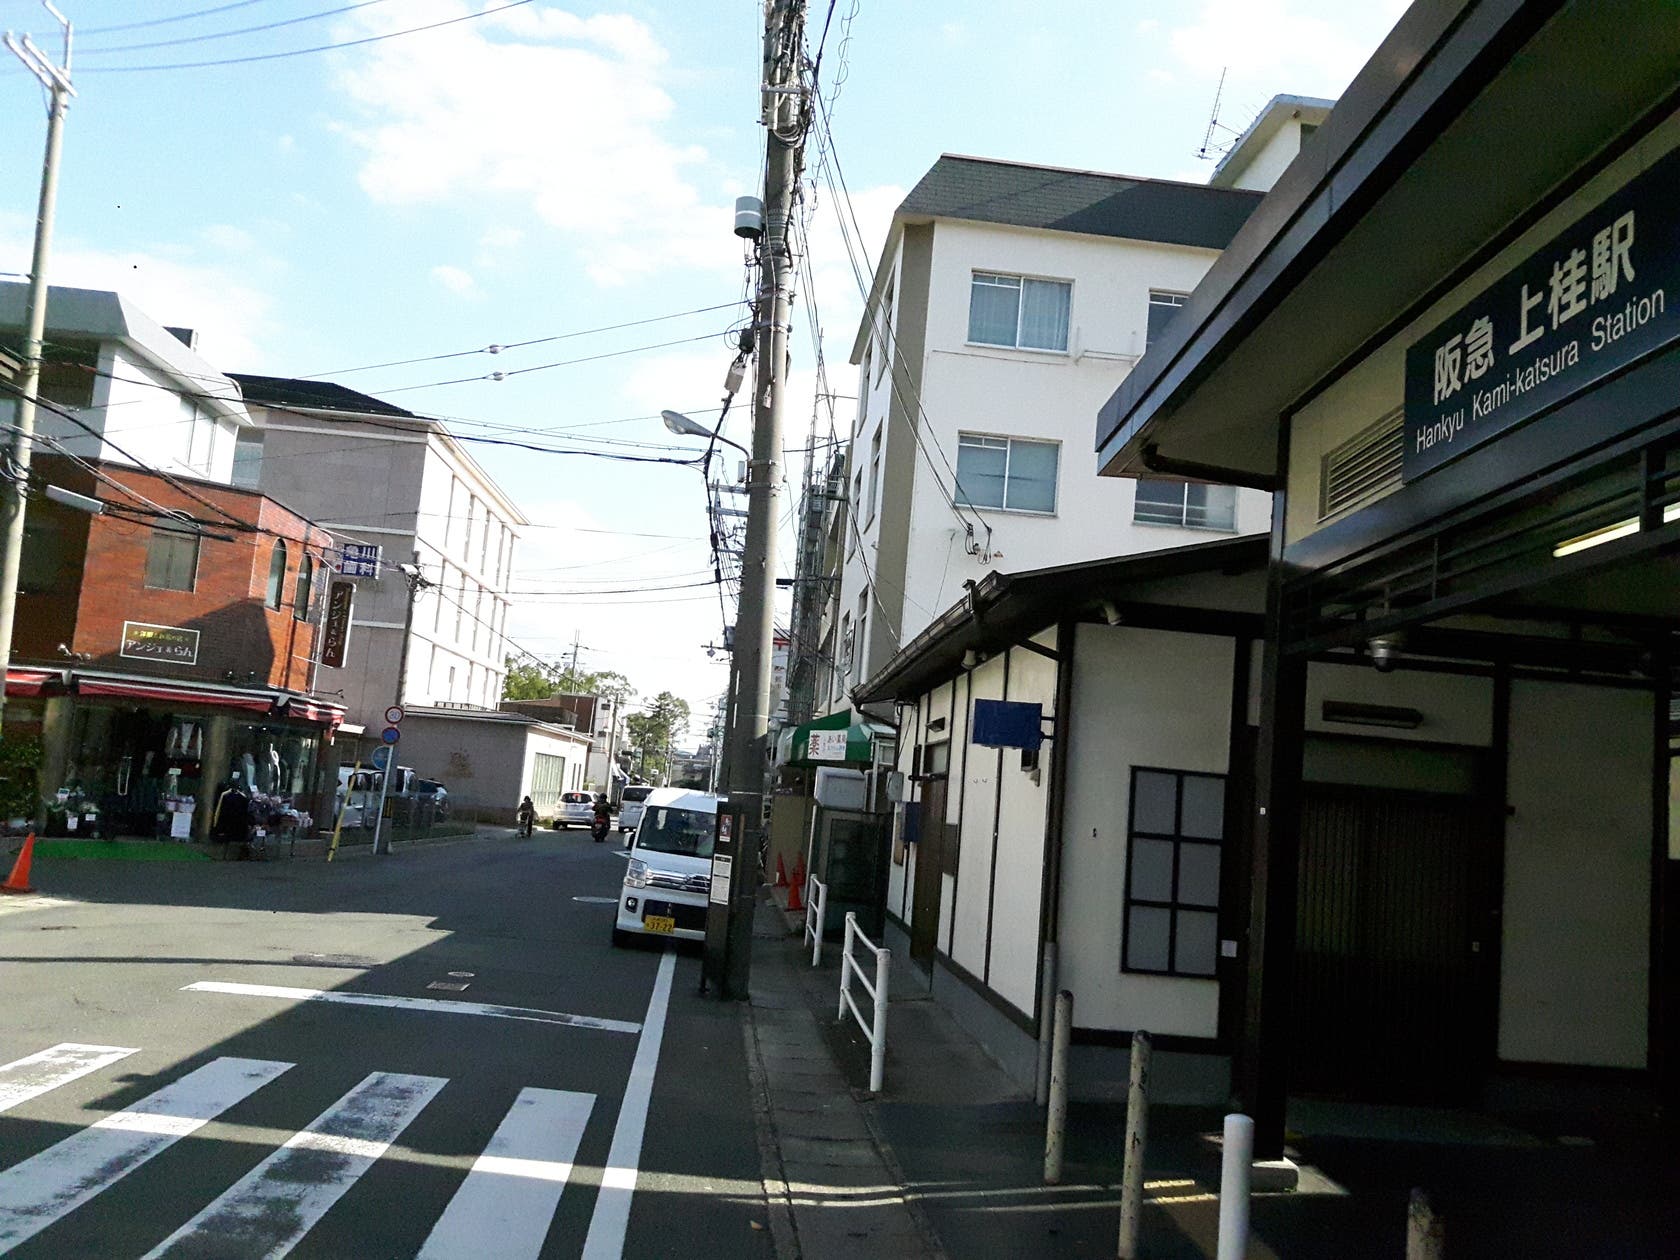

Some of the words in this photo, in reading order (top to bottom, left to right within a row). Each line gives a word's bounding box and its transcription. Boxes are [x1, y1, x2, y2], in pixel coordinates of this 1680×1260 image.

[1416, 408, 1465, 454] Hankyu
[1472, 340, 1580, 421] Kami-katsura
[1591, 288, 1665, 352] Station
[1433, 315, 1495, 406] 阪急
[1508, 209, 1636, 356] 上桂駅
